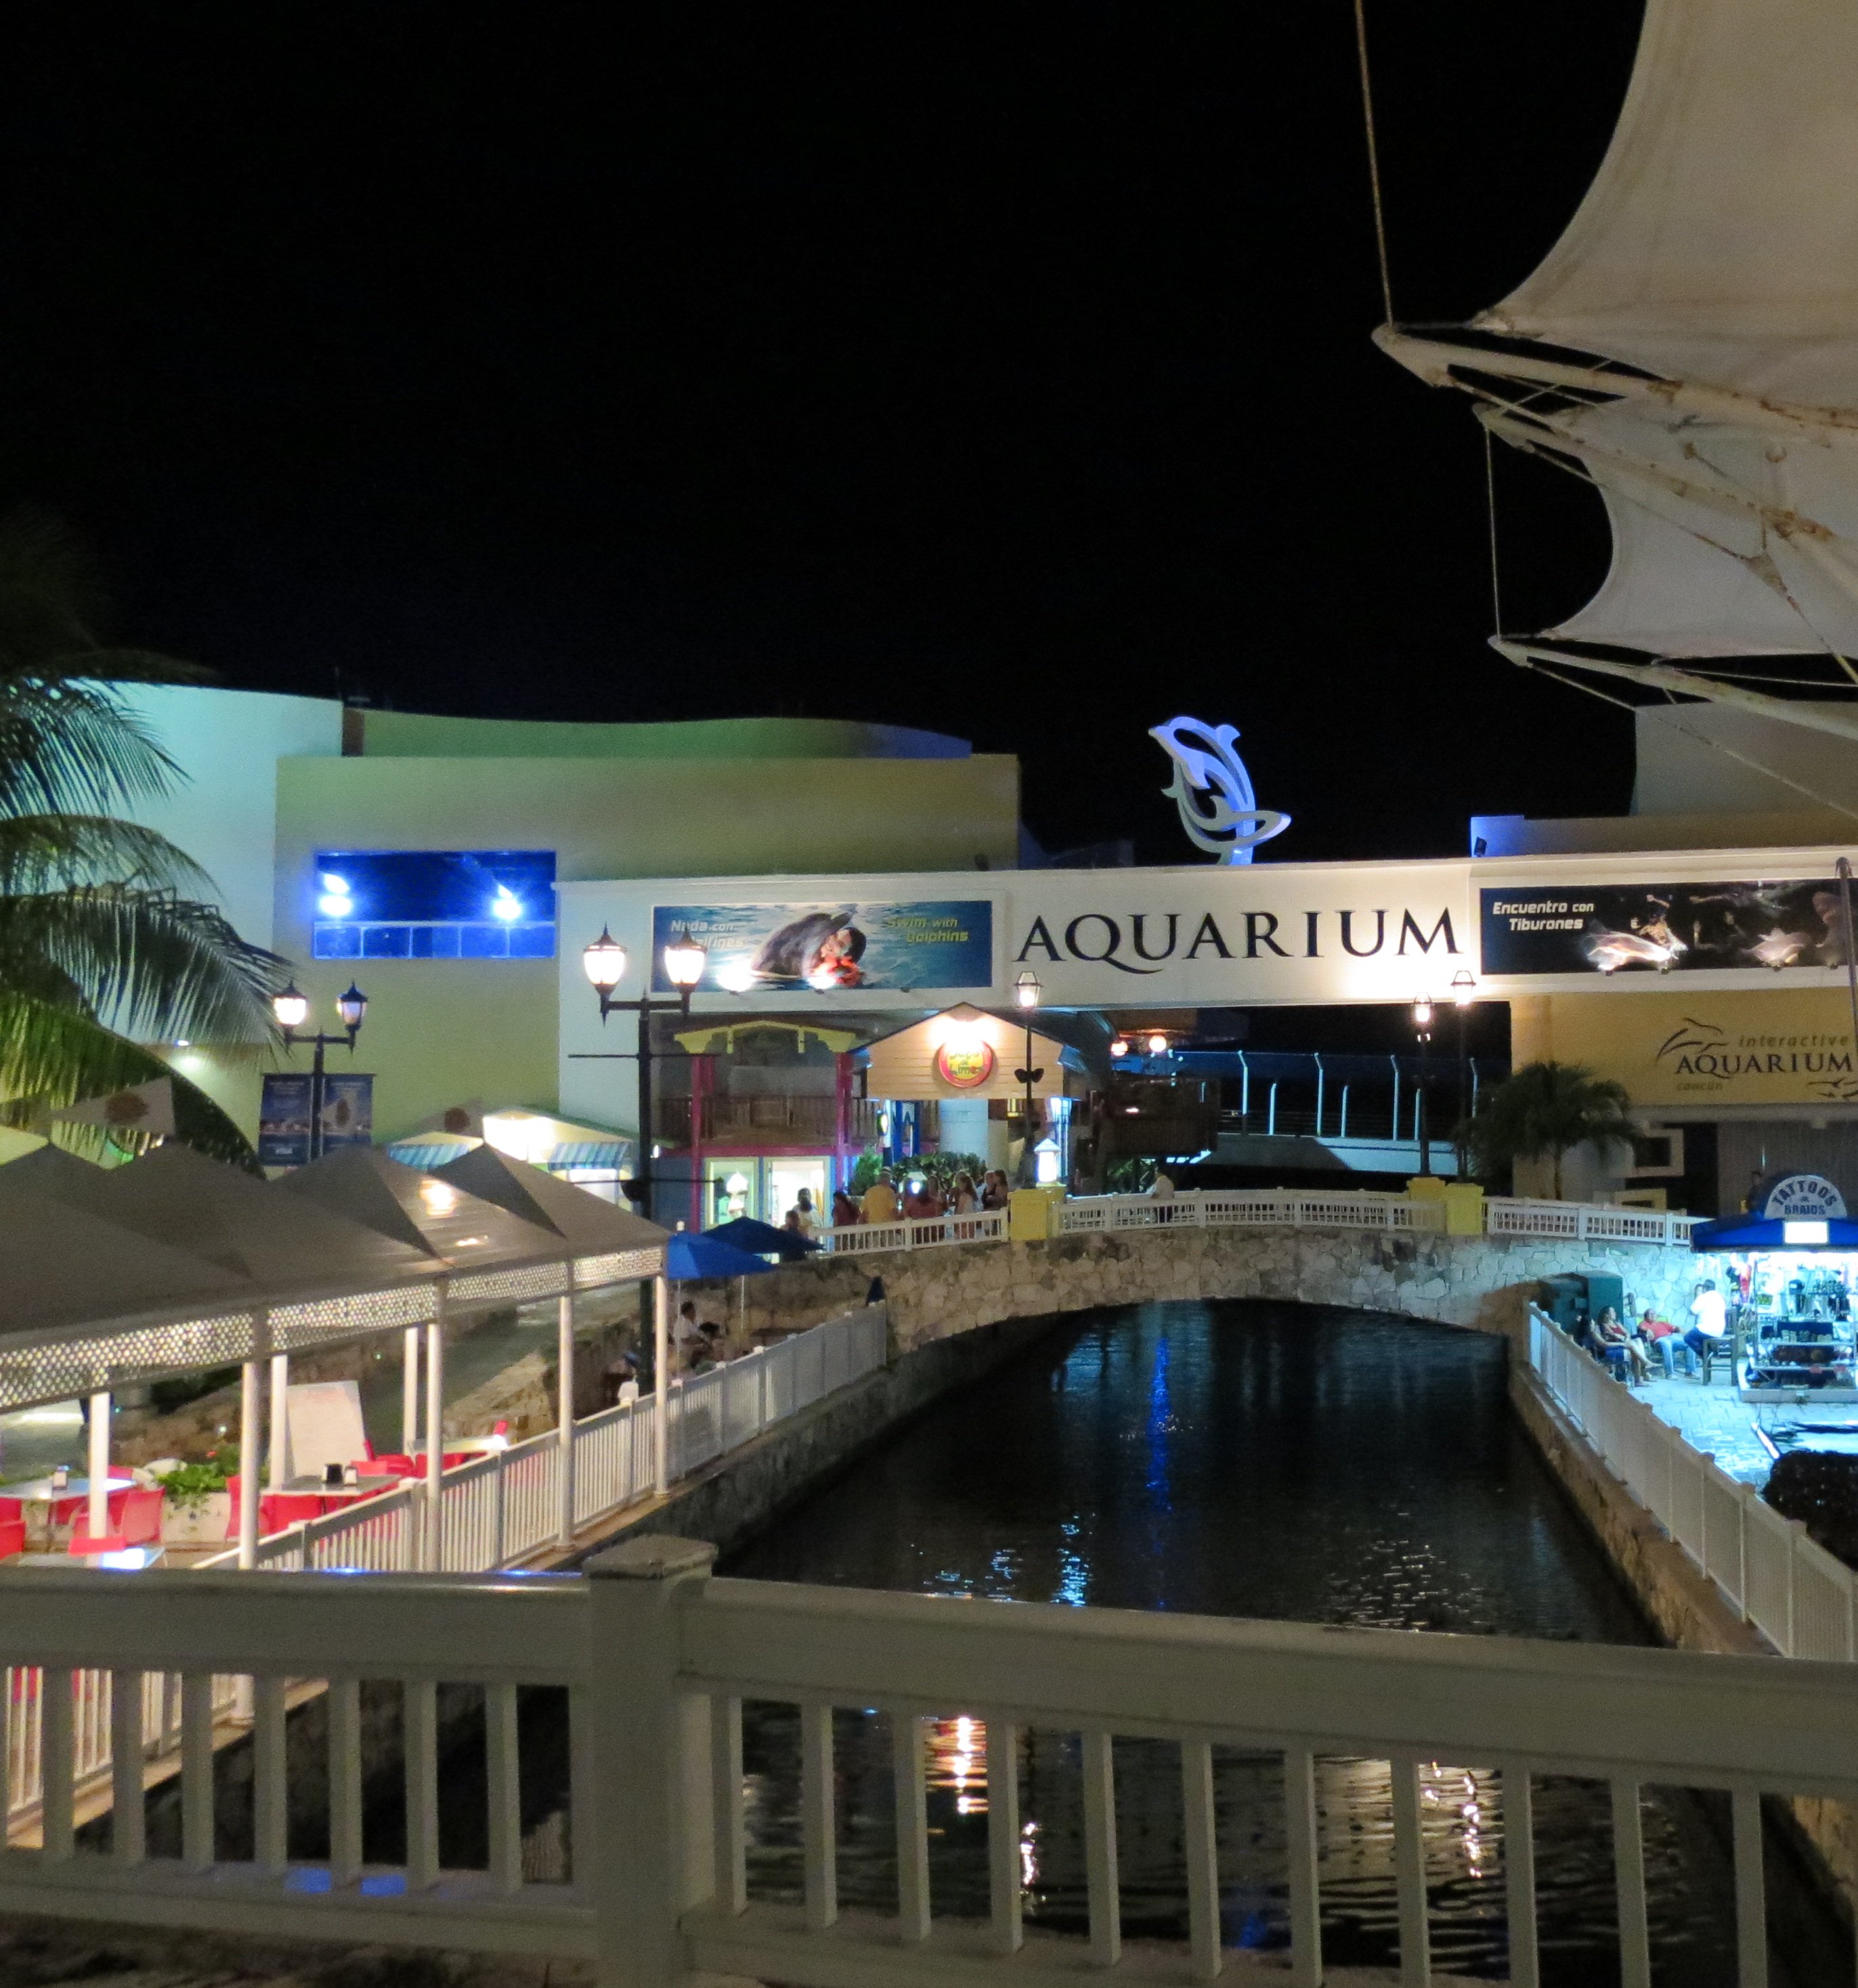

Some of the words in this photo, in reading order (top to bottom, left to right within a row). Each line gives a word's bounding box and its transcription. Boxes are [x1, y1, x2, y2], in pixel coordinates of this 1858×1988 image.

[1493, 901, 1568, 914] Encuentro
[1572, 903, 1594, 912] con
[1509, 918, 1584, 930] Tiburones
[691, 936, 743, 948] elfines
[1012, 907, 1463, 974] AQUARIUM
[1738, 1034, 1849, 1048] interactive
[1675, 1052, 1853, 1080] AQUARIUM
[1784, 1205, 1826, 1215] BRAIDS
